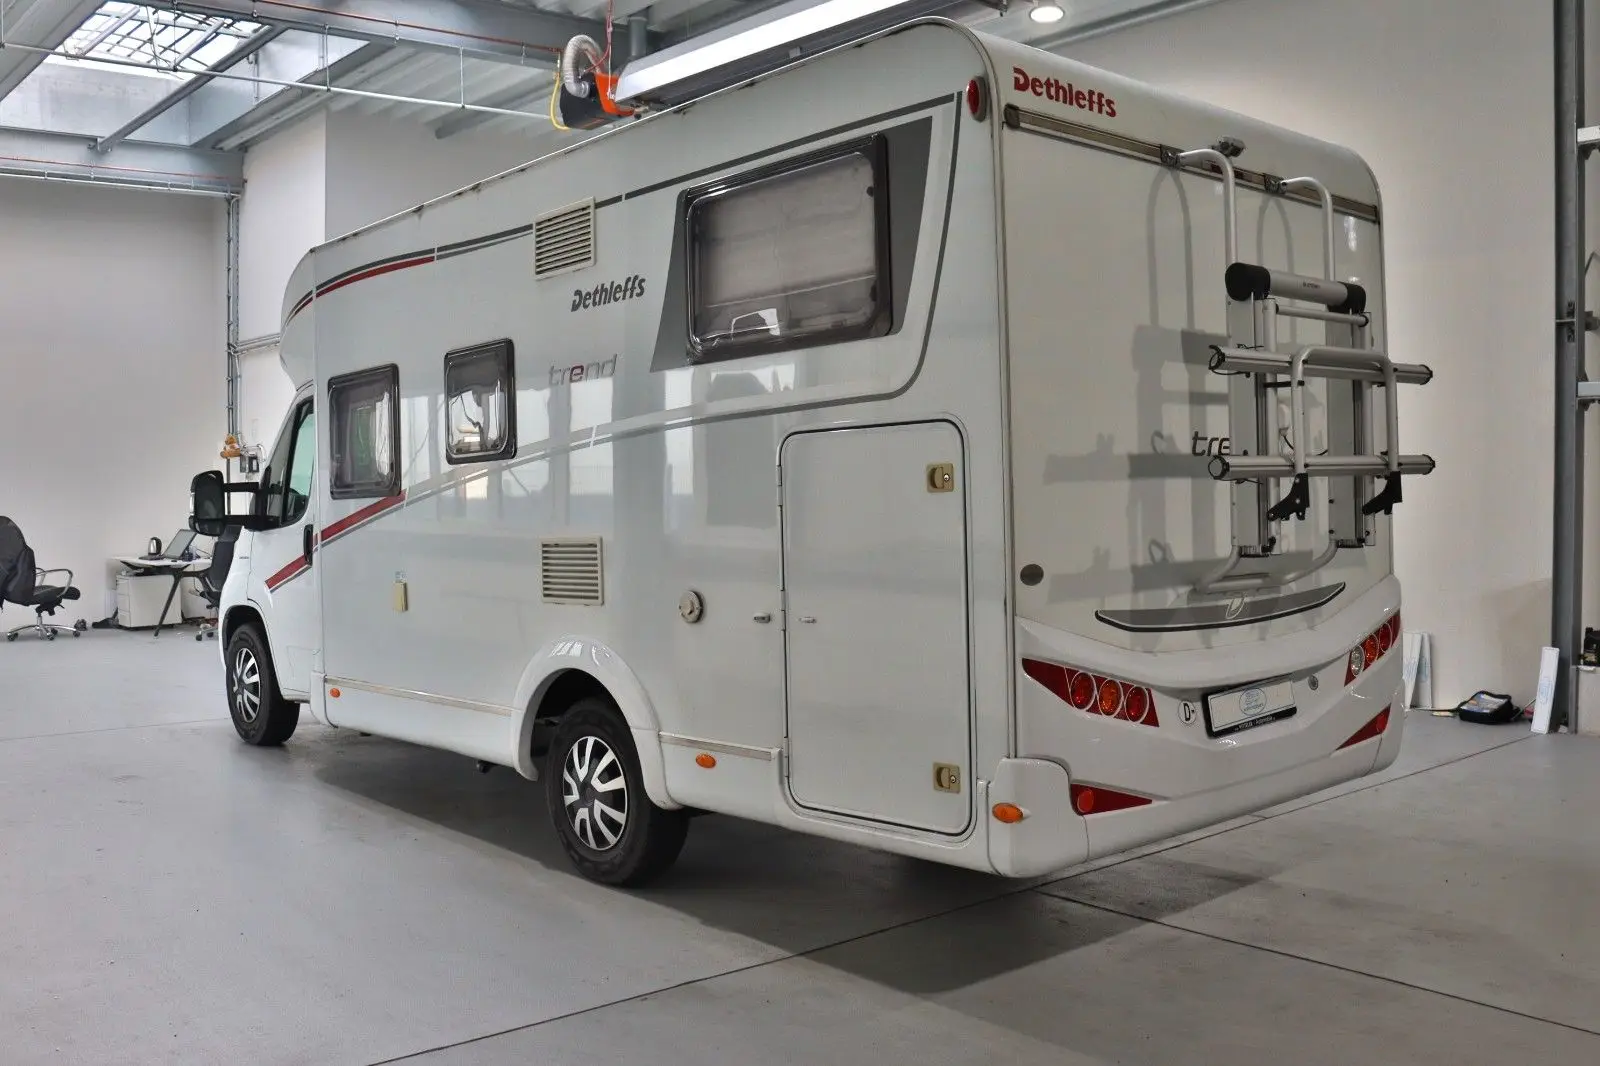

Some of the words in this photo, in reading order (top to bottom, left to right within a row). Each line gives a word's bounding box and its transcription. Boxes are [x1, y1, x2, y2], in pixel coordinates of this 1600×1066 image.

[1013, 66, 1117, 118] Dethleffs
[571, 274, 646, 312] Dethleffs
[548, 353, 617, 386] trend
[1192, 431, 1230, 456] tre
